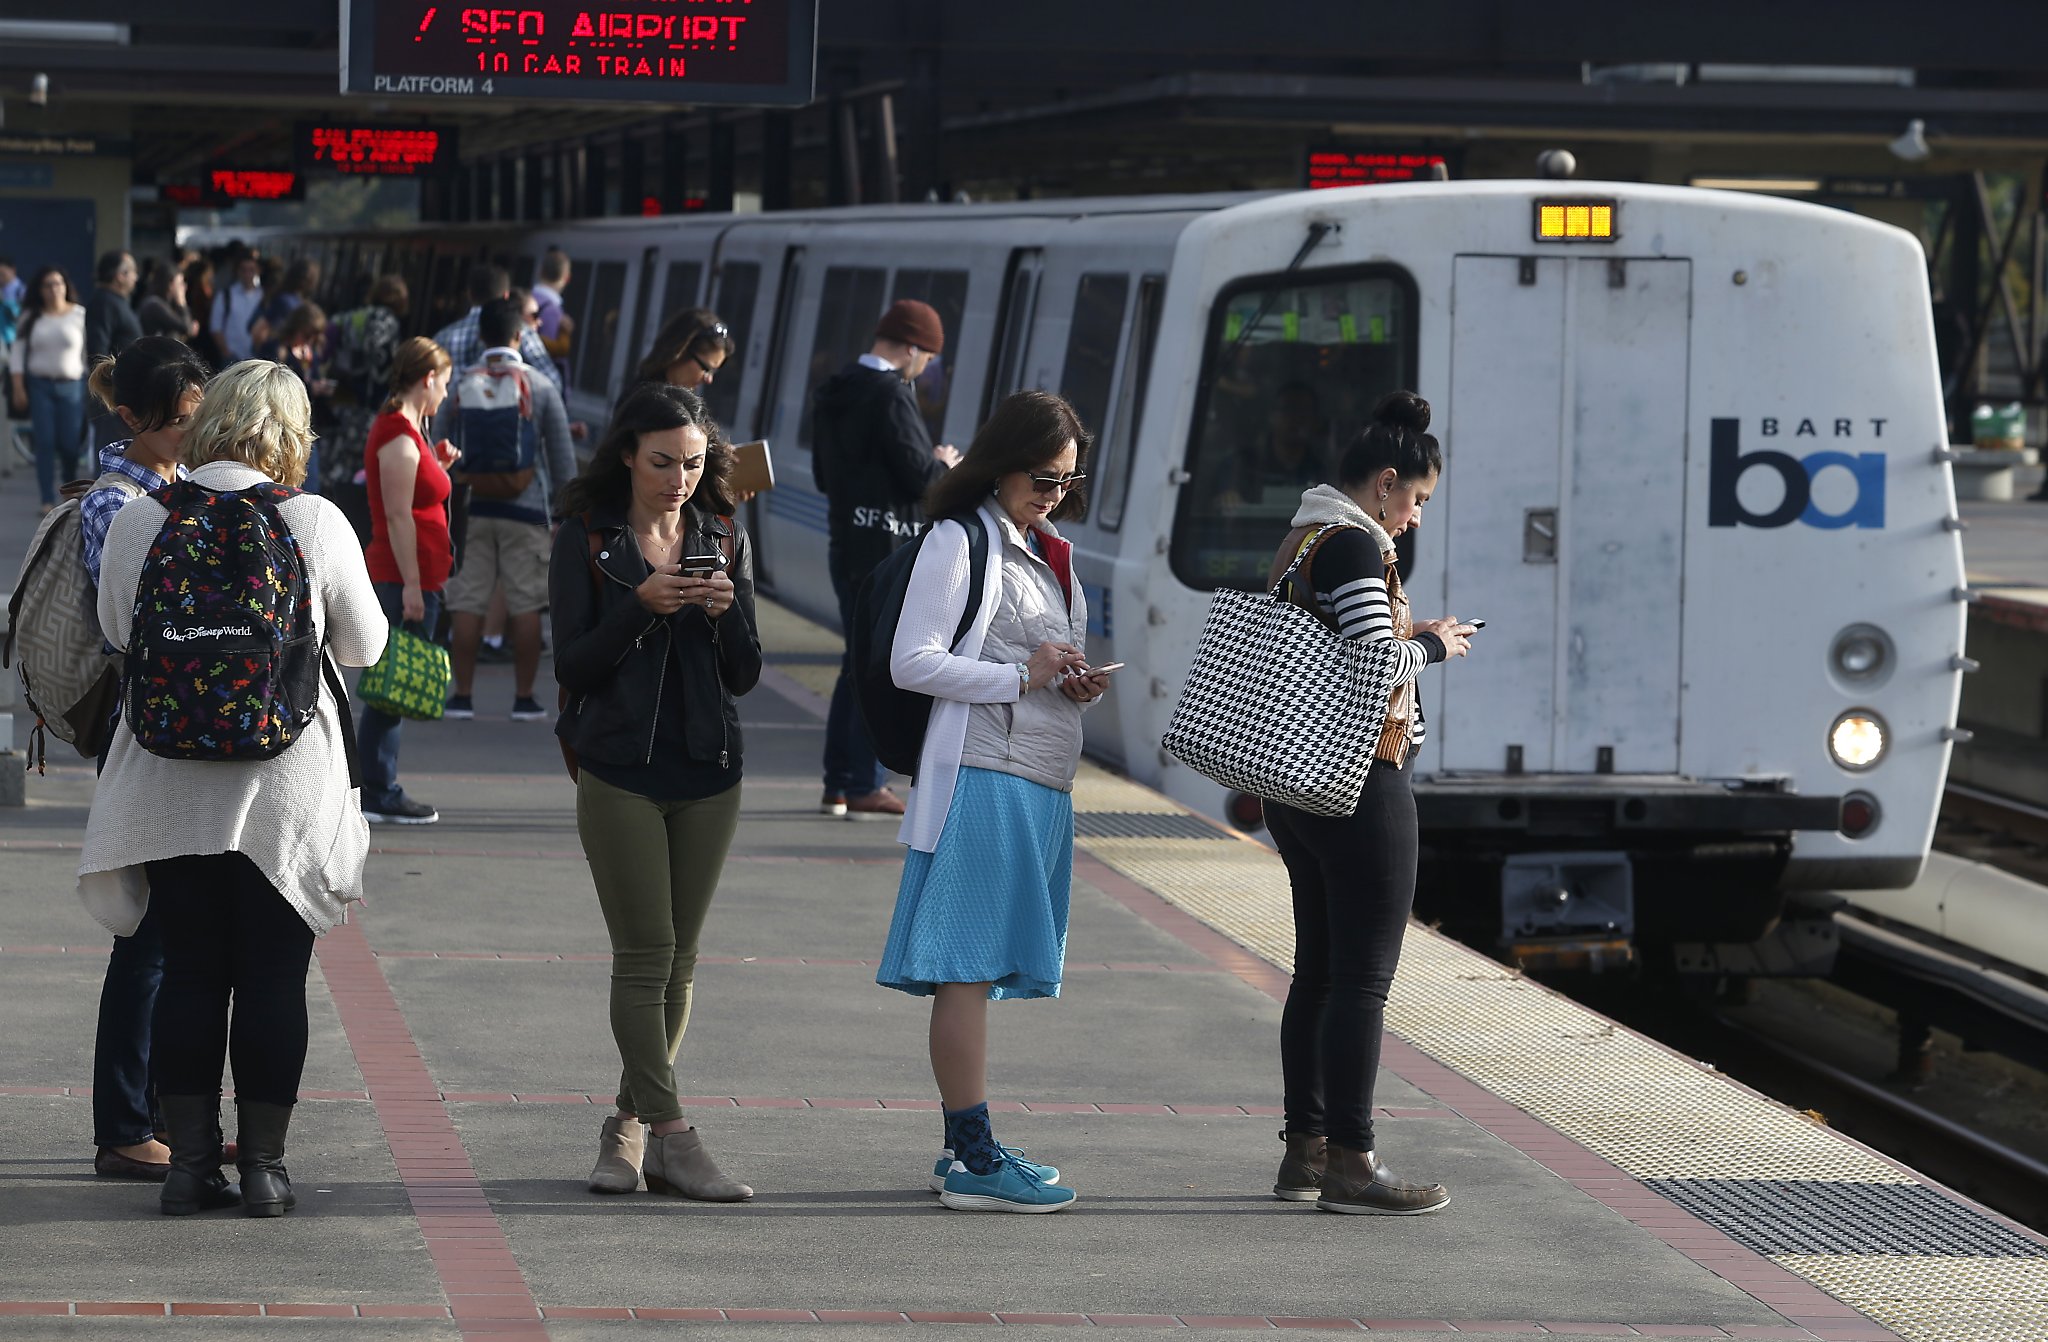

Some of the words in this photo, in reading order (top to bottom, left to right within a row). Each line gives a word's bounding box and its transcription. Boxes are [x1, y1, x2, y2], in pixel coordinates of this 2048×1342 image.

[461, 9, 545, 45] SFO
[569, 12, 747, 51] AIRPORT
[477, 52, 508, 73] 10
[524, 53, 581, 75] CAR
[597, 55, 686, 78] TRAIN
[374, 75, 474, 93] PLATFORM
[481, 78, 495, 94] 4
[1761, 417, 1888, 438] BART
[1707, 417, 1887, 530] ba
[853, 505, 881, 528] SF
